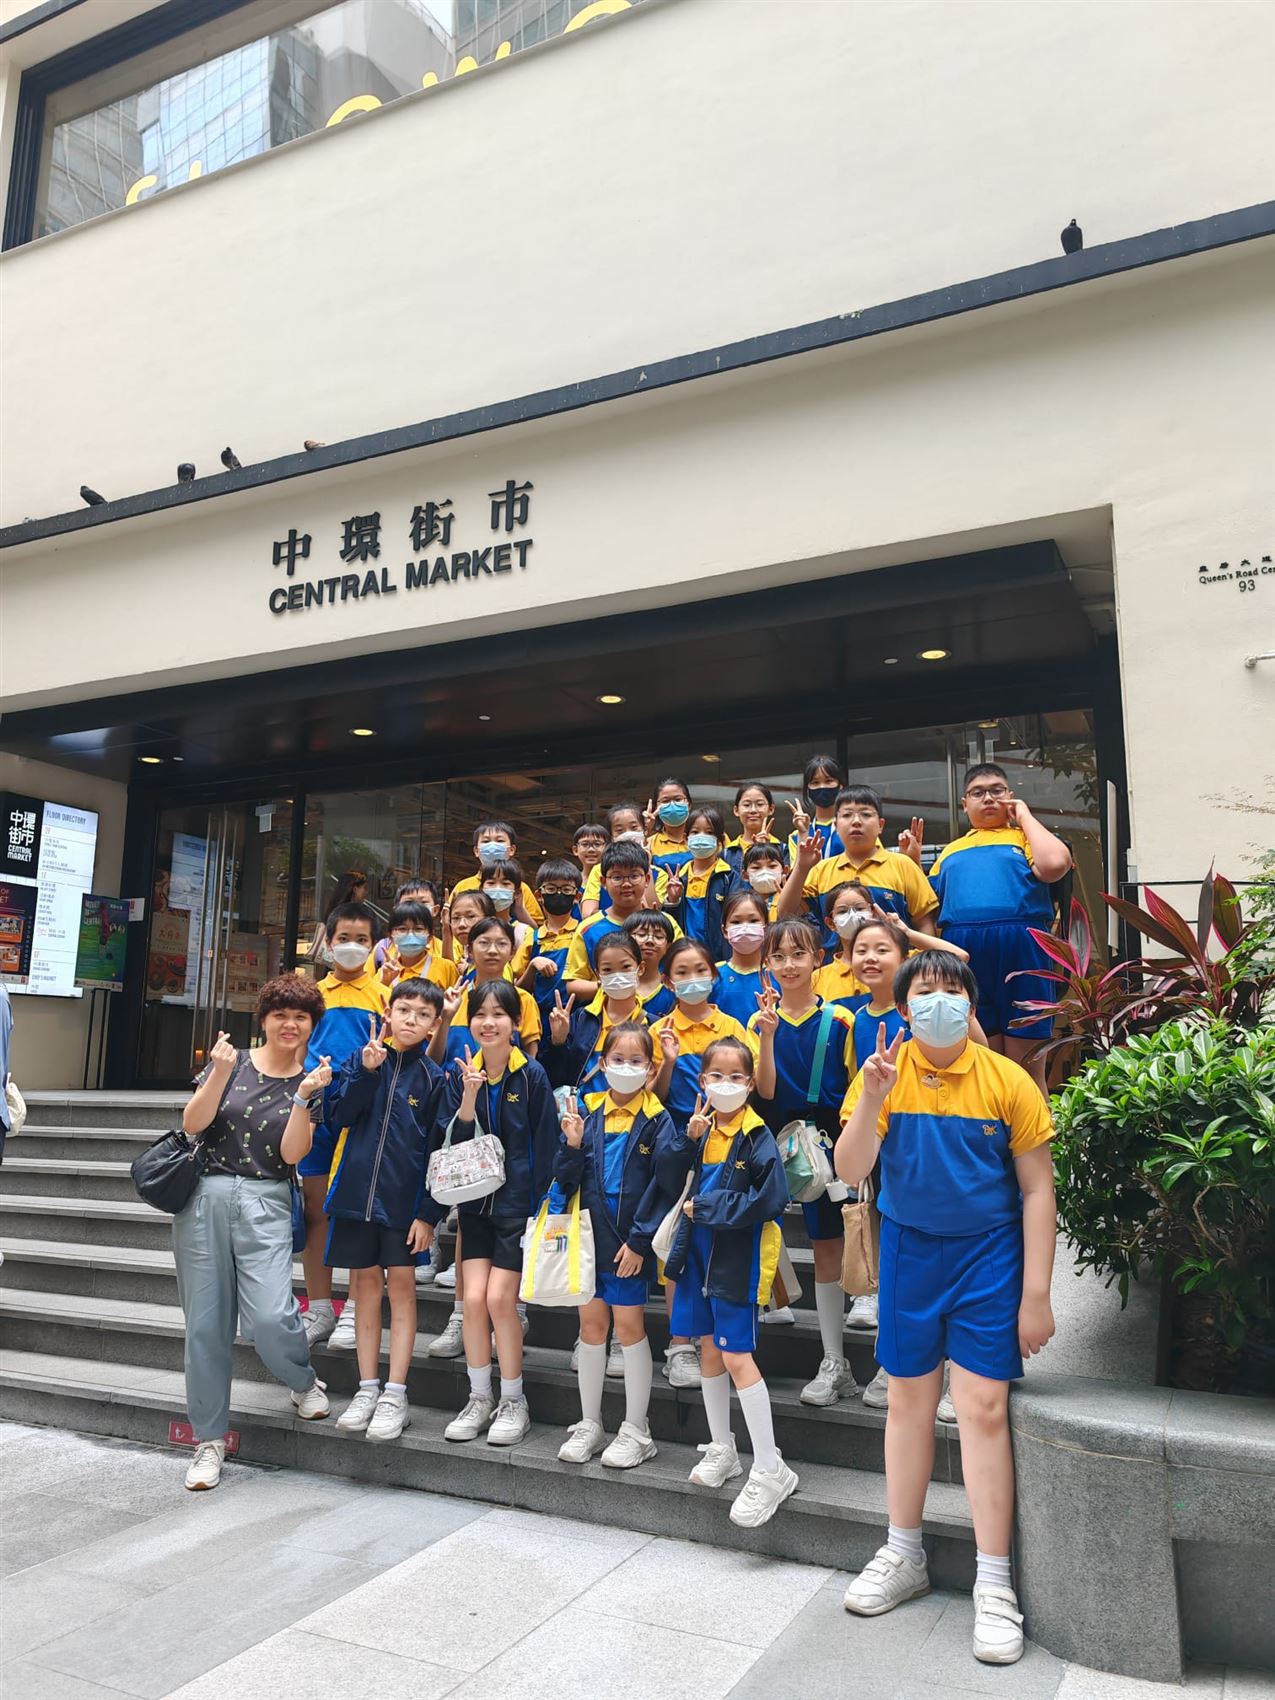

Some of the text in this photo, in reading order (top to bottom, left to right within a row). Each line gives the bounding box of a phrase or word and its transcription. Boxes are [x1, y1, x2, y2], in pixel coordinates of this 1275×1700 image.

[272, 480, 533, 576] 中環街市
[269, 539, 533, 613] CENTRAL MARKET
[1199, 573, 1232, 584] Queen's
[1236, 568, 1258, 578] Road
[1239, 579, 1255, 592] 93
[62, 813, 86, 824] DIRECTORY
